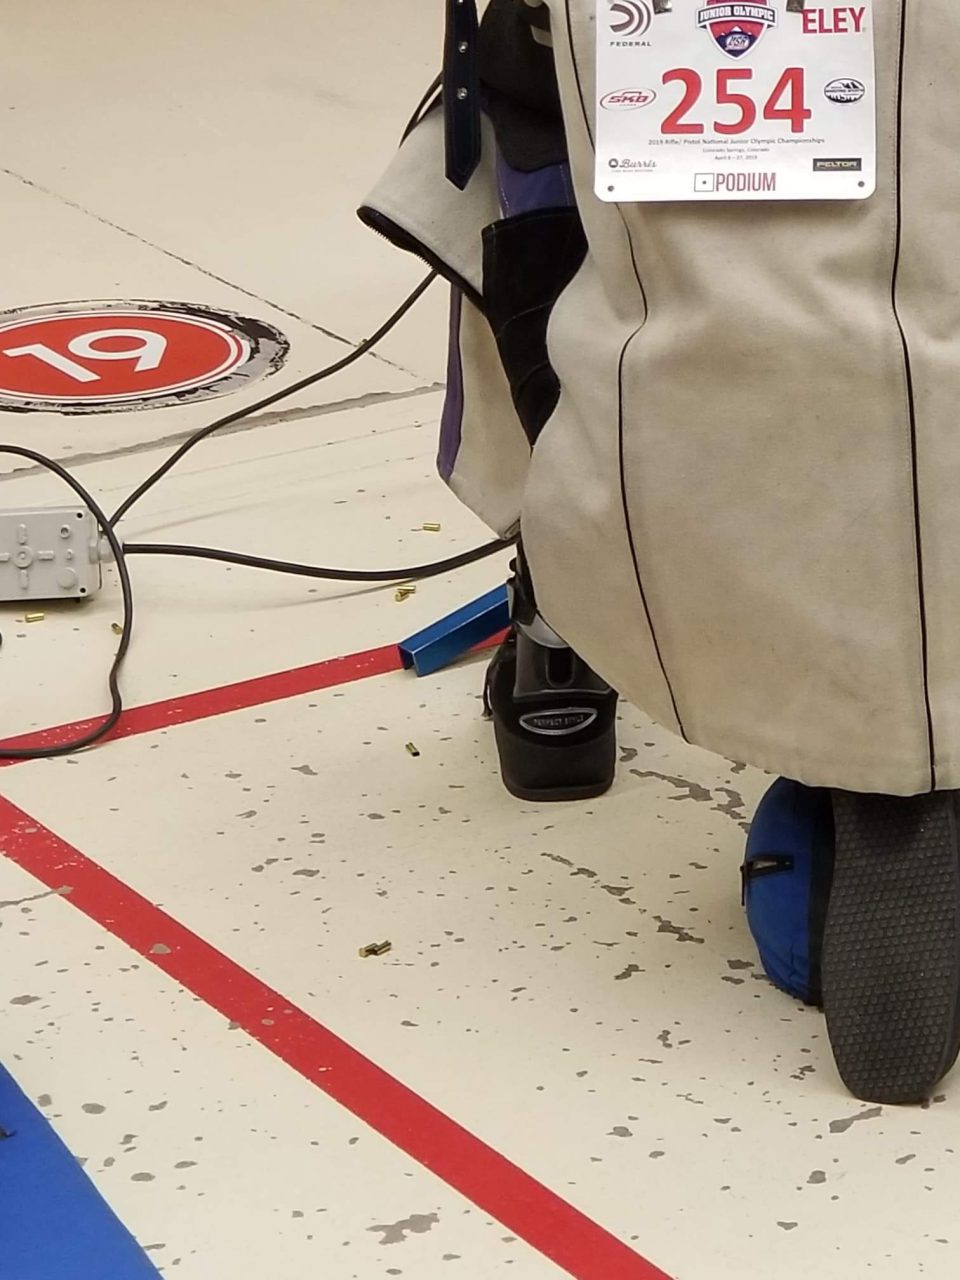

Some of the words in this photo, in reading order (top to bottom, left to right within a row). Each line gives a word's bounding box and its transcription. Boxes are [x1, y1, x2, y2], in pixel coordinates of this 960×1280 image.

[700, 6, 732, 21] JUNIOR
[733, 6, 774, 21] OLYMPIC
[802, 7, 866, 34] ELEY
[660, 67, 812, 135] 254
[715, 172, 776, 192] PODIUM
[2, 328, 168, 383] 19
